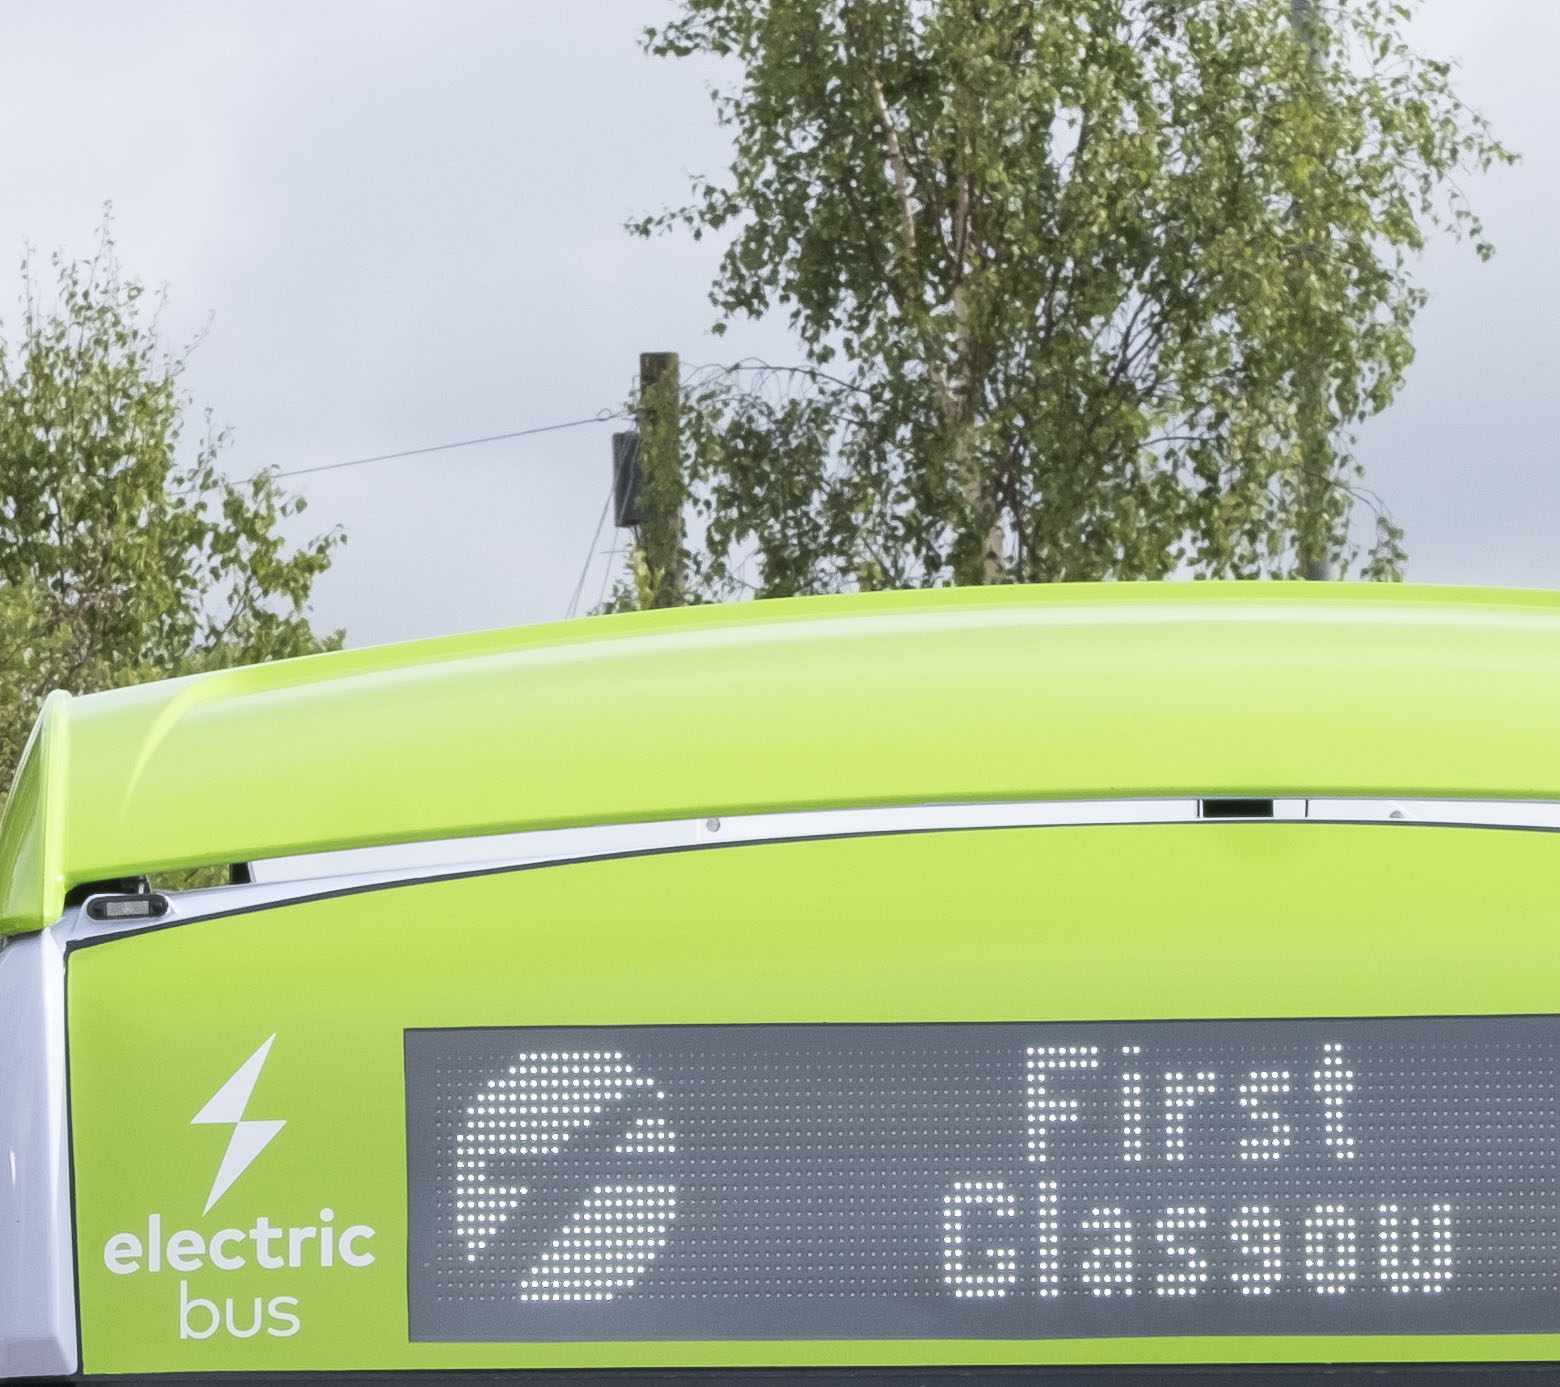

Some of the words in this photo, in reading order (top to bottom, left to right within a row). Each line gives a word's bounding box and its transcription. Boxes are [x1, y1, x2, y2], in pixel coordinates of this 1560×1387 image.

[1026, 1042, 1354, 1161] First
[102, 1207, 377, 1275] electric
[943, 1181, 1453, 1297] Glasgow
[179, 1279, 301, 1340] bus
